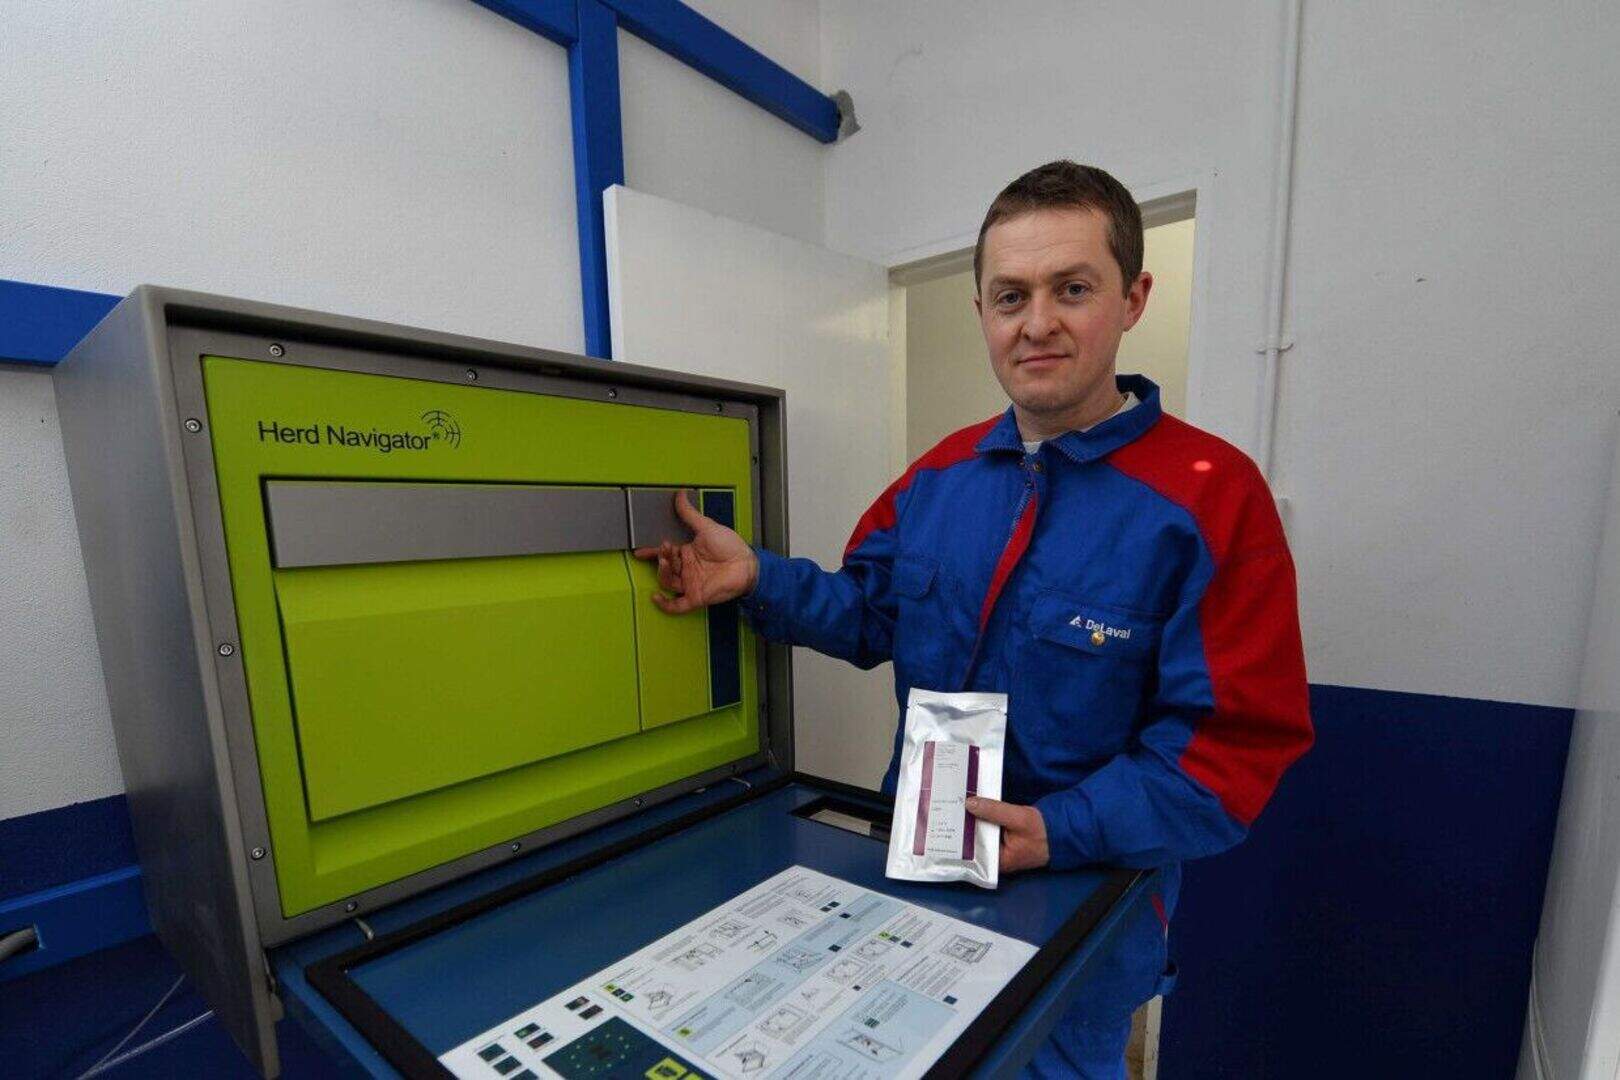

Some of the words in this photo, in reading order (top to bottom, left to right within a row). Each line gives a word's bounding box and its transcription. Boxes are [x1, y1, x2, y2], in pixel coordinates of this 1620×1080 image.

[257, 420, 320, 445] Herd
[326, 425, 432, 453] Navigator
[1085, 619, 1131, 639] DeLaval
